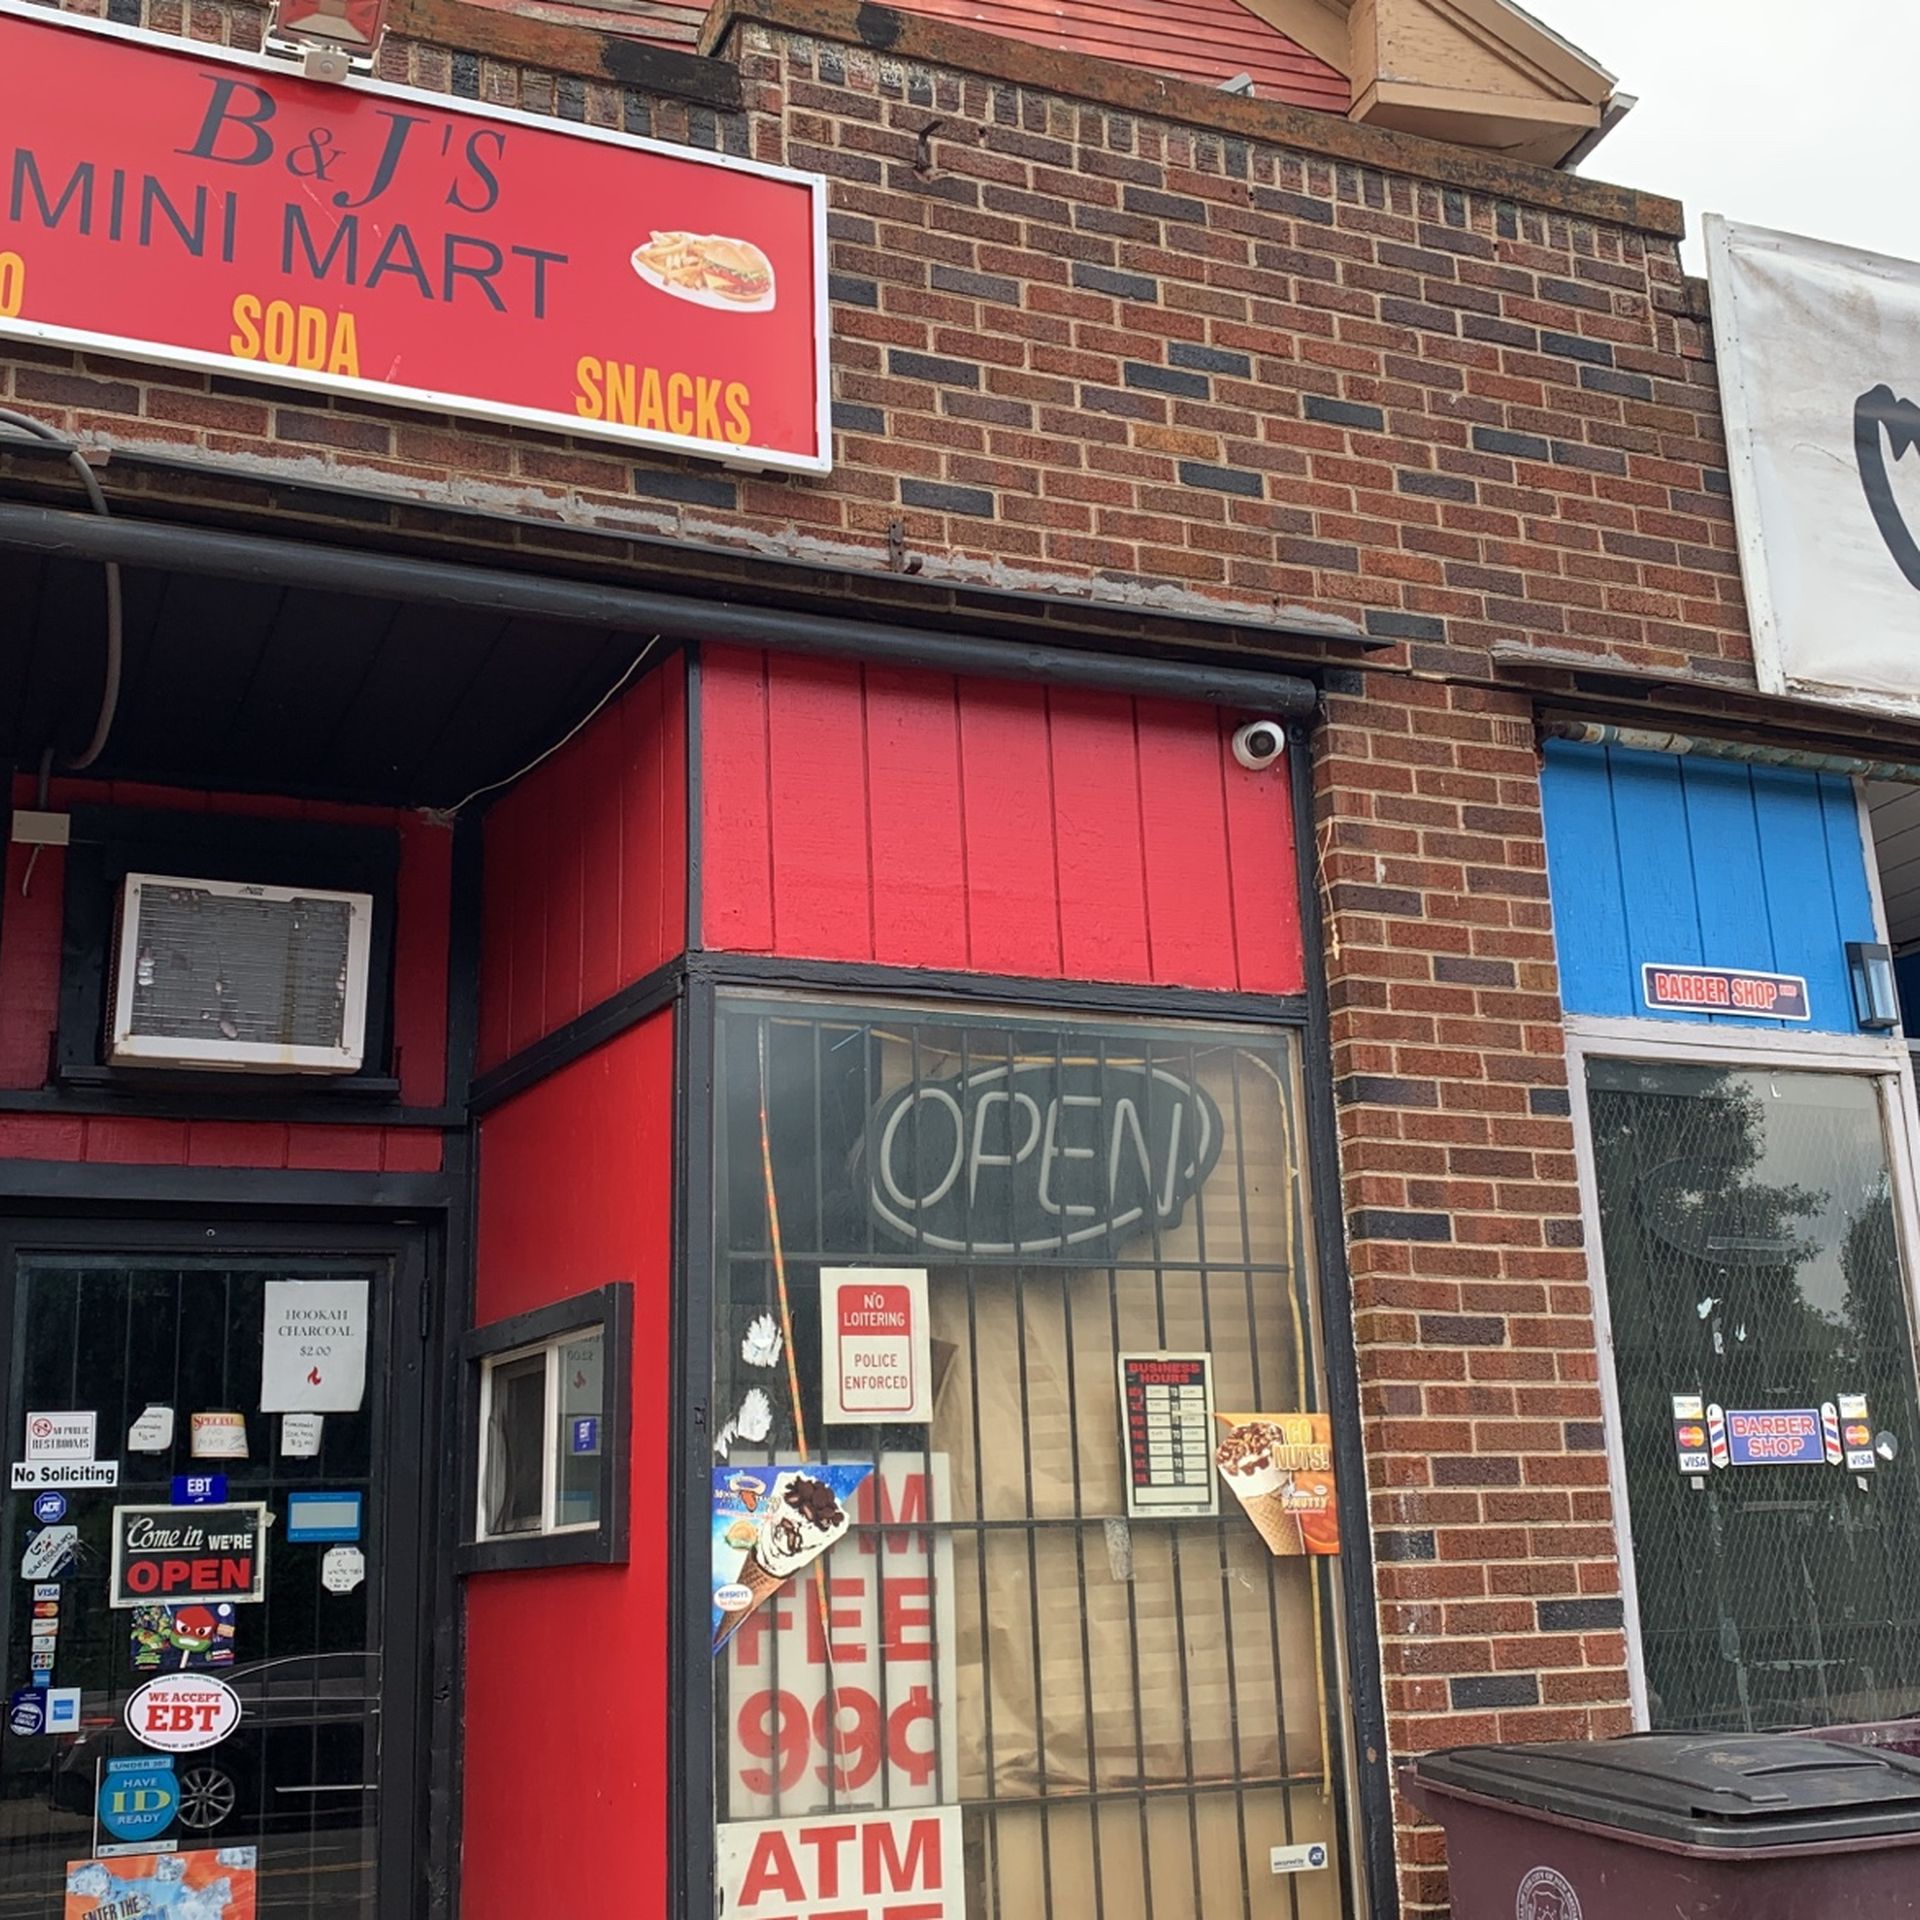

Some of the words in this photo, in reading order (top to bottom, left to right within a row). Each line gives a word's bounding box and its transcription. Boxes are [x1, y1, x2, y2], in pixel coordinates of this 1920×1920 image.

[9, 147, 237, 263] MINI
[282, 202, 569, 320] MART
[230, 293, 360, 378] SODA
[574, 355, 752, 445] SNACKS
[1655, 972, 1730, 1006] BARBER
[1730, 979, 1777, 1010] SHOP
[880, 1087, 1183, 1216] OPEN
[863, 1293, 885, 1310] NO
[285, 1309, 348, 1321] HOOKAH
[843, 1311, 906, 1327] LOITERING
[278, 1325, 355, 1337] CHARCOAL
[854, 1353, 898, 1368] POLICE
[1128, 1363, 1201, 1374] BUSINESS
[844, 1375, 908, 1390] ENFORCED
[1139, 1374, 1190, 1384] HOURS
[1286, 1418, 1313, 1444] GO
[1731, 1415, 1816, 1437] BARBER
[1272, 1443, 1331, 1470] NUTS!
[1748, 1437, 1806, 1457] SHOP
[1683, 1456, 1707, 1468] VISA
[1851, 1454, 1873, 1466] VISA
[14, 1467, 35, 1482] No
[40, 1465, 115, 1484] Soliciting
[187, 1477, 213, 1493] EBT
[127, 1518, 181, 1548] Come
[182, 1525, 203, 1547] in
[208, 1534, 252, 1550] WE'RE
[127, 1558, 250, 1593] OPEN
[37, 1588, 59, 1596] VISA
[149, 1692, 169, 1702] WE
[172, 1692, 222, 1702] ACCEPT
[145, 1705, 221, 1731] EBT
[737, 1685, 938, 1796] 99¢
[115, 1761, 149, 1770] UNDER
[123, 1778, 158, 1788] HAVE
[112, 1790, 171, 1813] ID
[117, 1813, 160, 1825] READY
[738, 1818, 943, 1907] ATM
[119, 1896, 142, 1918] THE
